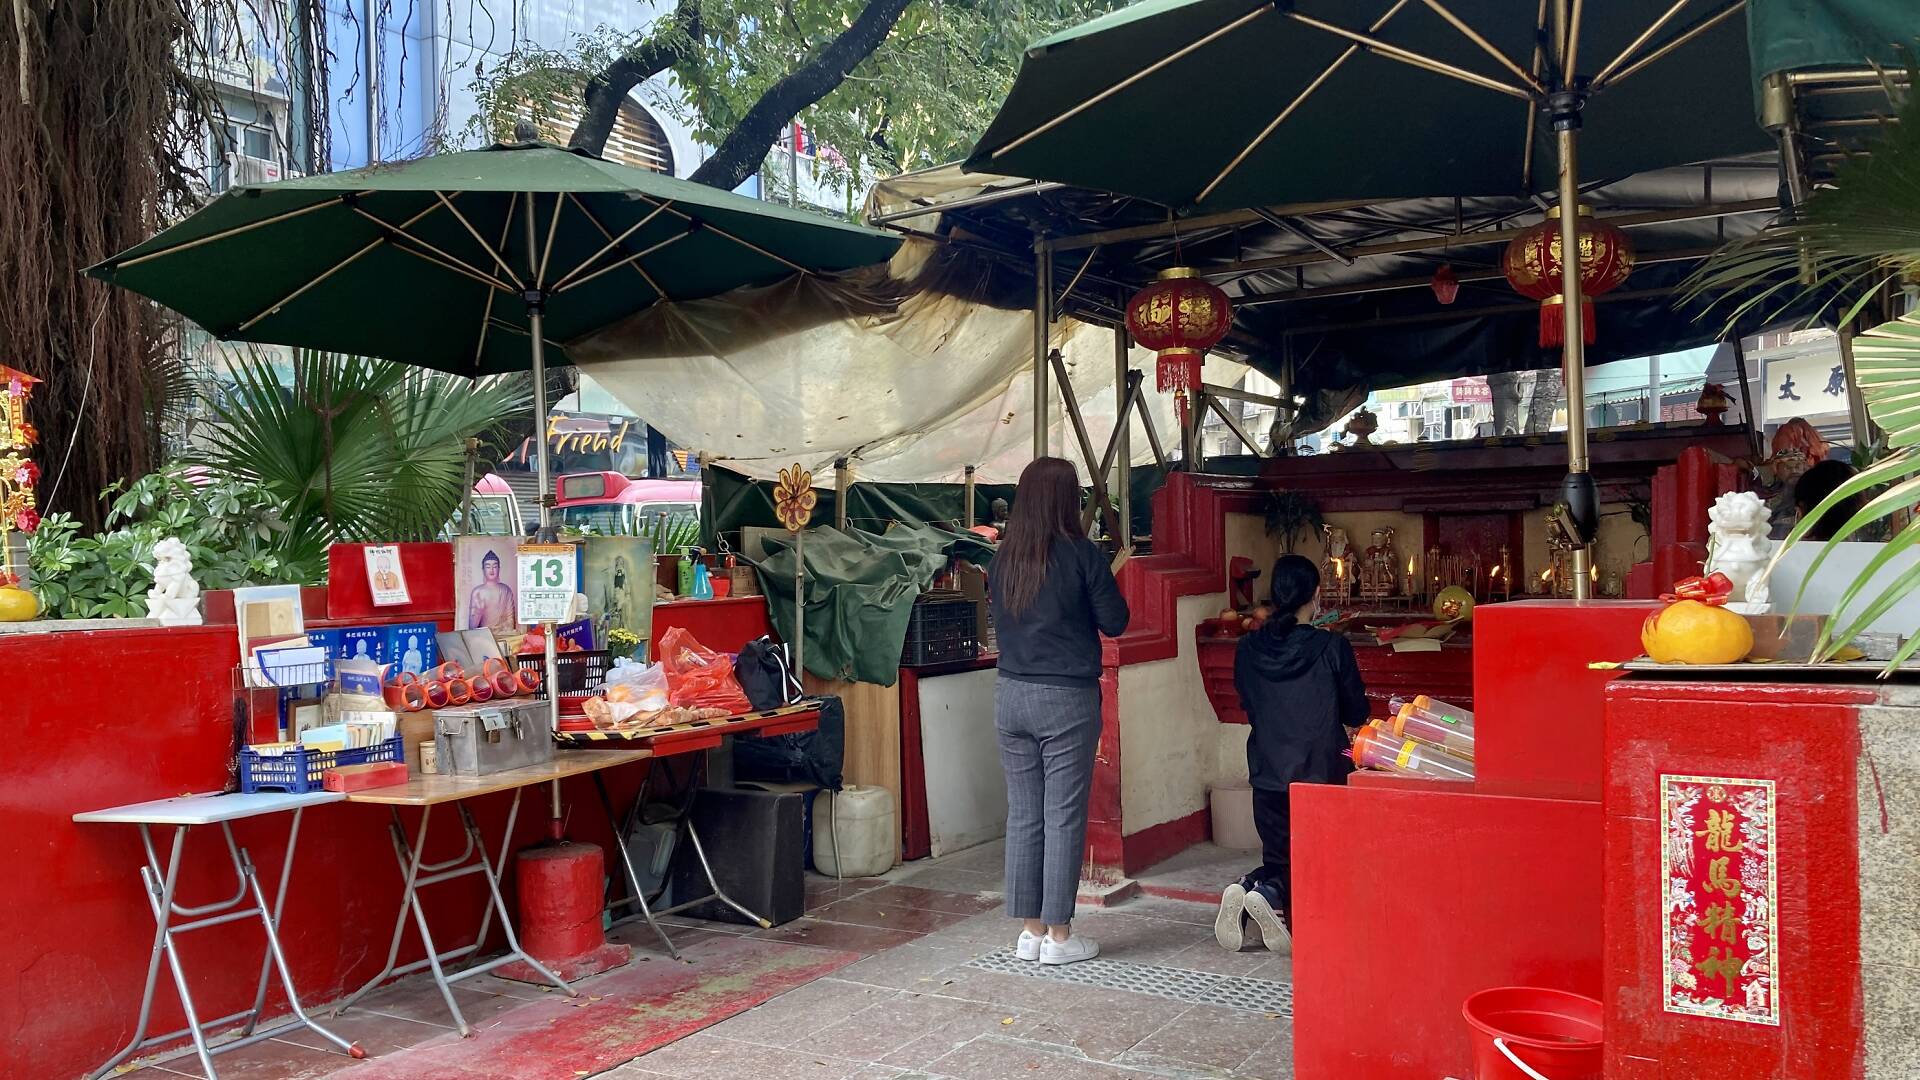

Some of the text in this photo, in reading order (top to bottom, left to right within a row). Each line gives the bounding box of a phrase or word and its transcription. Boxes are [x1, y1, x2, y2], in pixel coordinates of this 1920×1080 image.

[546, 415, 630, 455] Friend
[530, 558, 564, 587] 13
[1694, 808, 1744, 998] 龍馬精神
